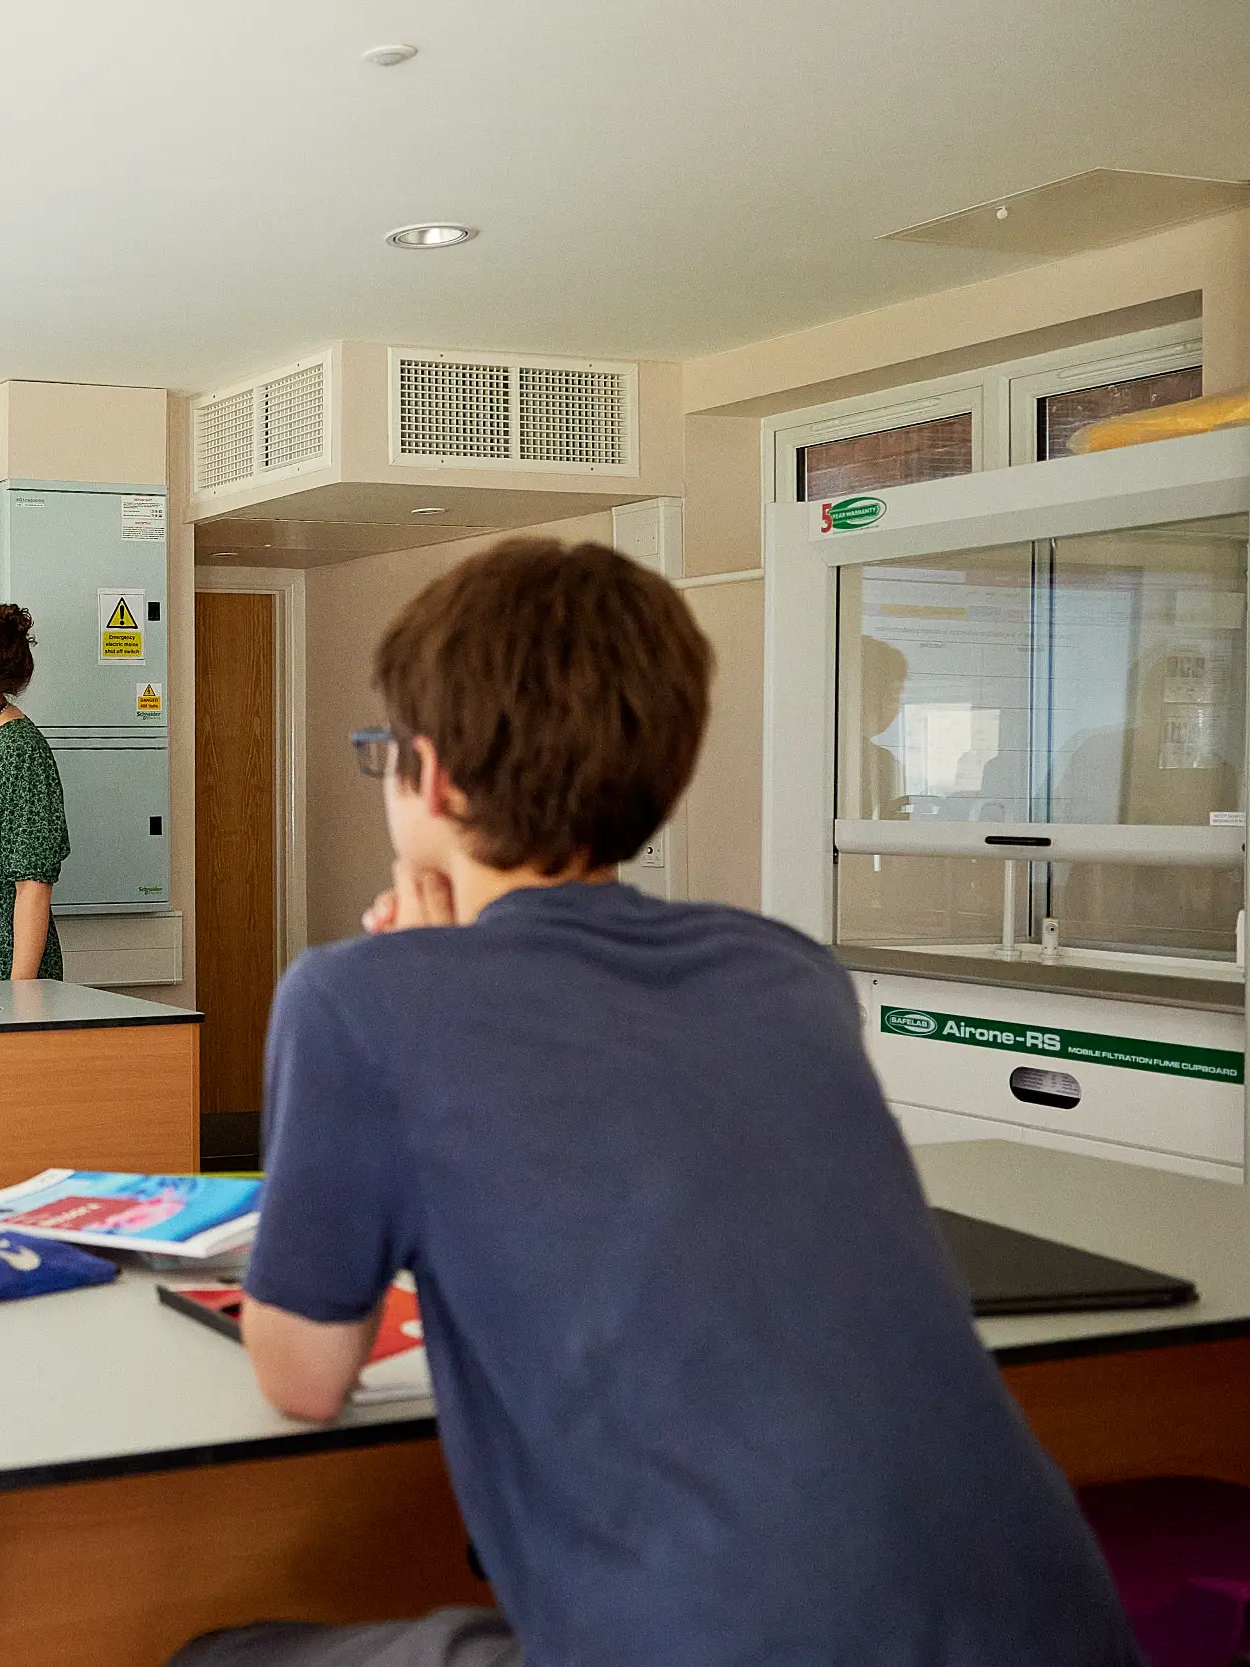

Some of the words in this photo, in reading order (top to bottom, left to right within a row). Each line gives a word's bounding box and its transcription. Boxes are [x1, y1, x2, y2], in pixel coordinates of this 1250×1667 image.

[821, 503, 833, 533] 5
[832, 512, 846, 520] YEAR
[845, 507, 876, 518] WARRANTY
[891, 1016, 928, 1029] SAFELAB
[942, 1019, 1061, 1052] Airone-RS
[1067, 1046, 1102, 1058] MOBILE
[1101, 1050, 1153, 1066] FILTRATION
[1153, 1058, 1181, 1070] FUME
[1181, 1062, 1238, 1077] CUPBOARD
